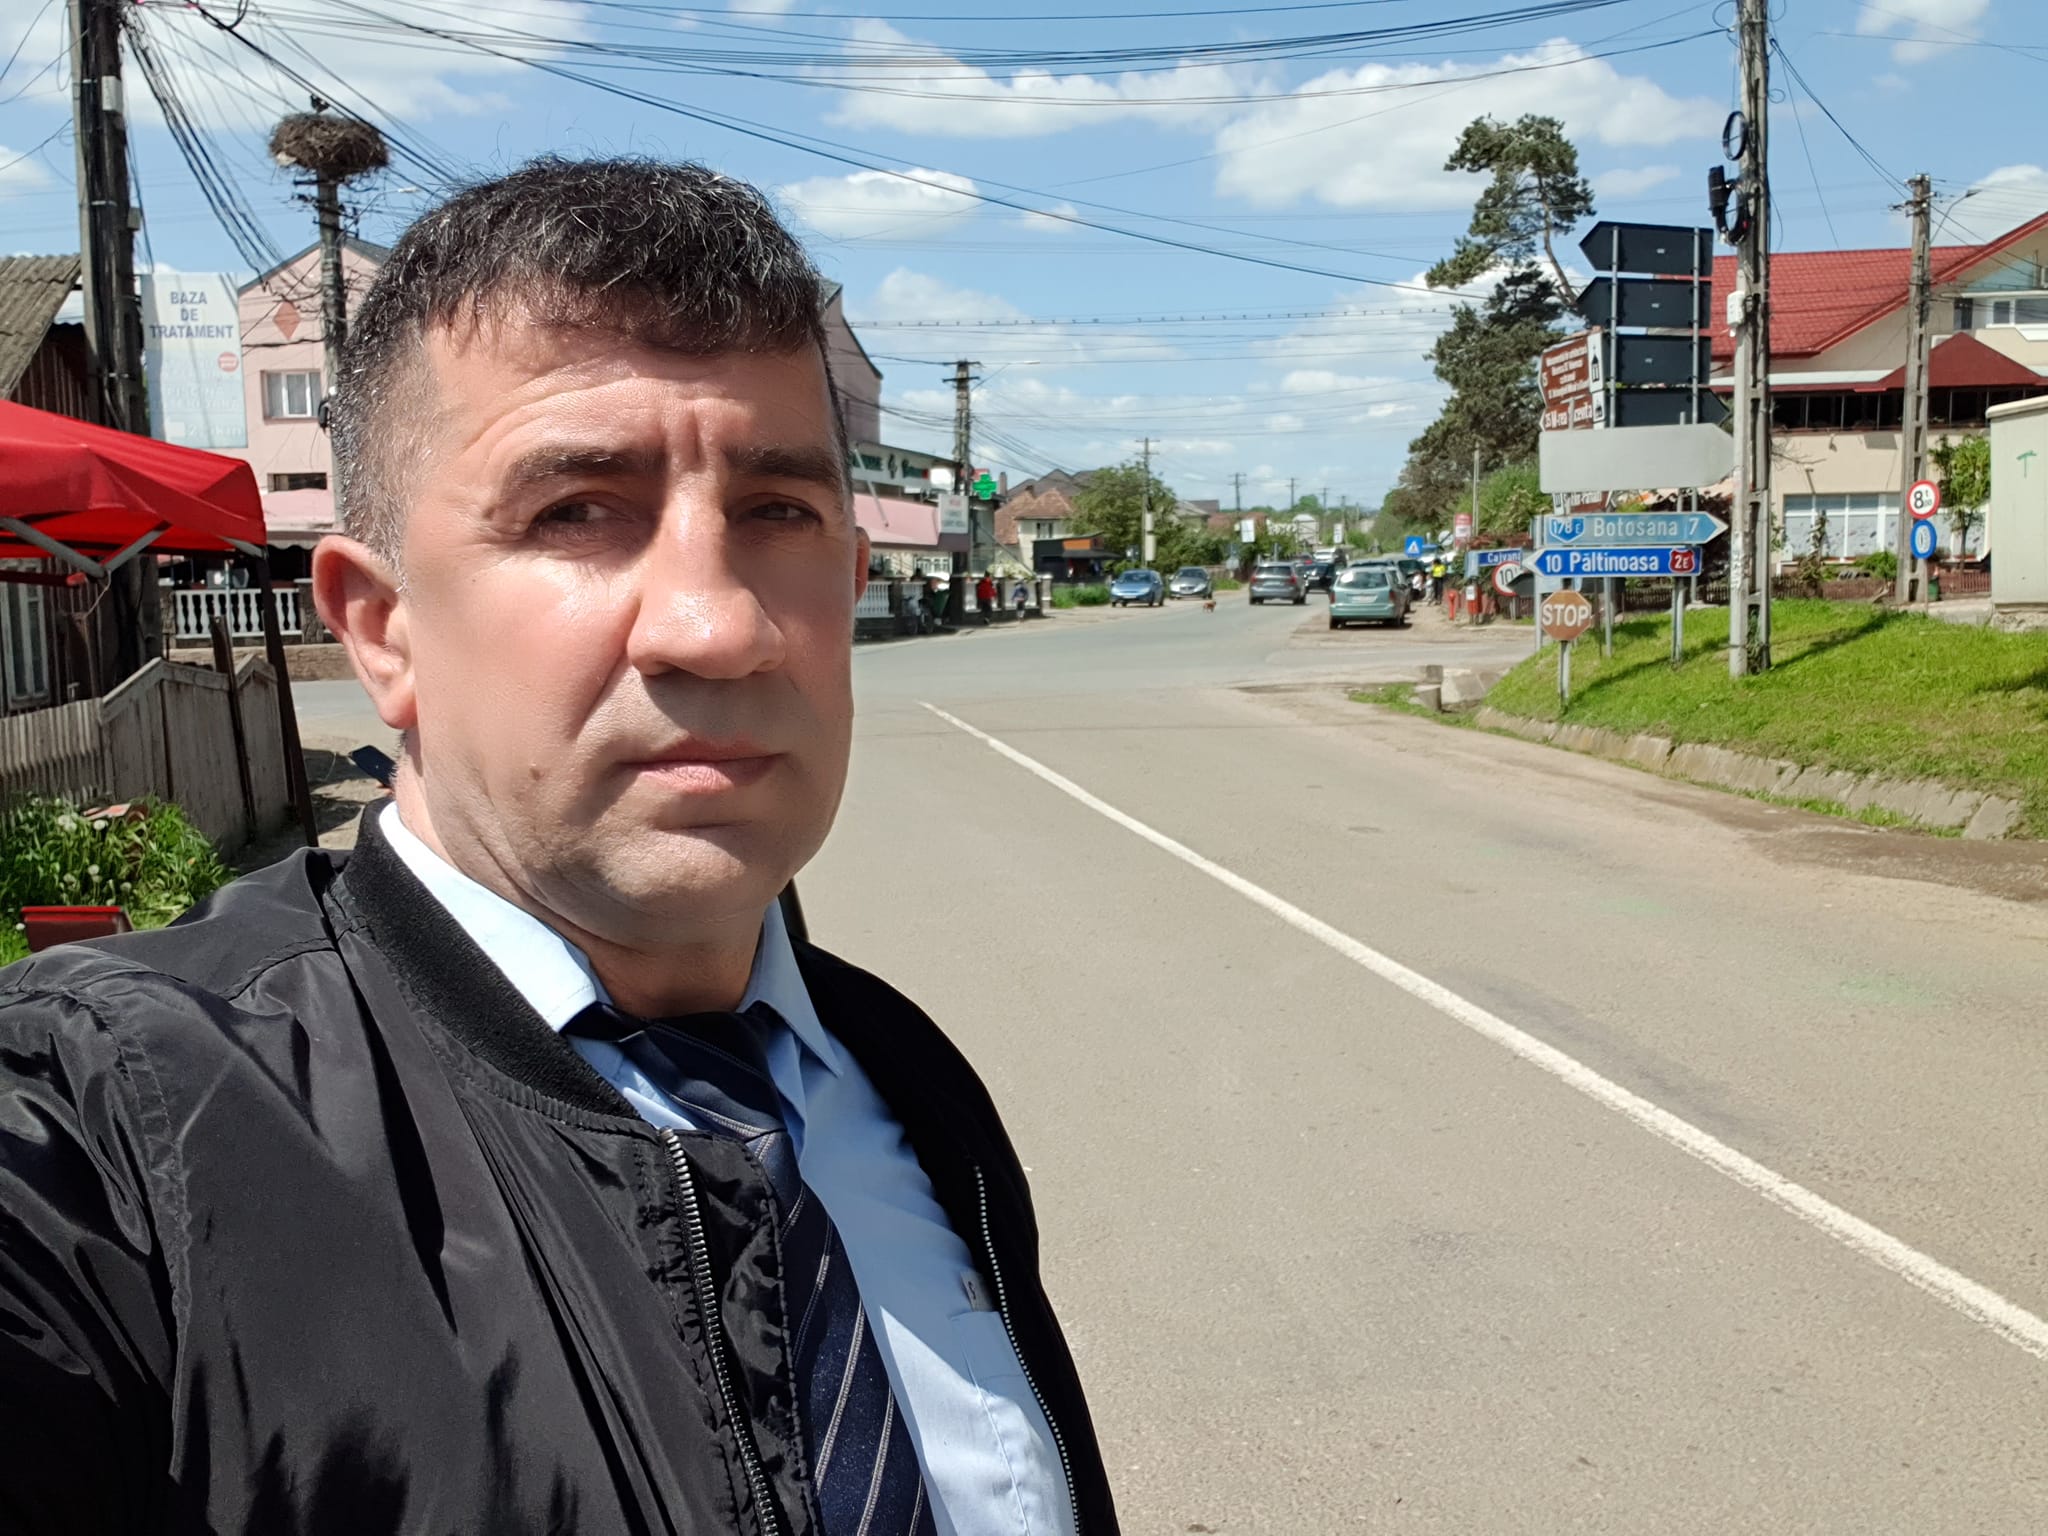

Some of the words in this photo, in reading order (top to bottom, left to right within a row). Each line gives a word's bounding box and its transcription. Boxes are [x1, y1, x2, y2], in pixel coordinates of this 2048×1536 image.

[171, 291, 208, 305] BAZA
[180, 308, 199, 321] DE
[149, 325, 234, 339] TRATAMENT
[1689, 518, 1699, 535] 7
[1545, 554, 1562, 573] 10
[1542, 603, 1589, 627] STOP
